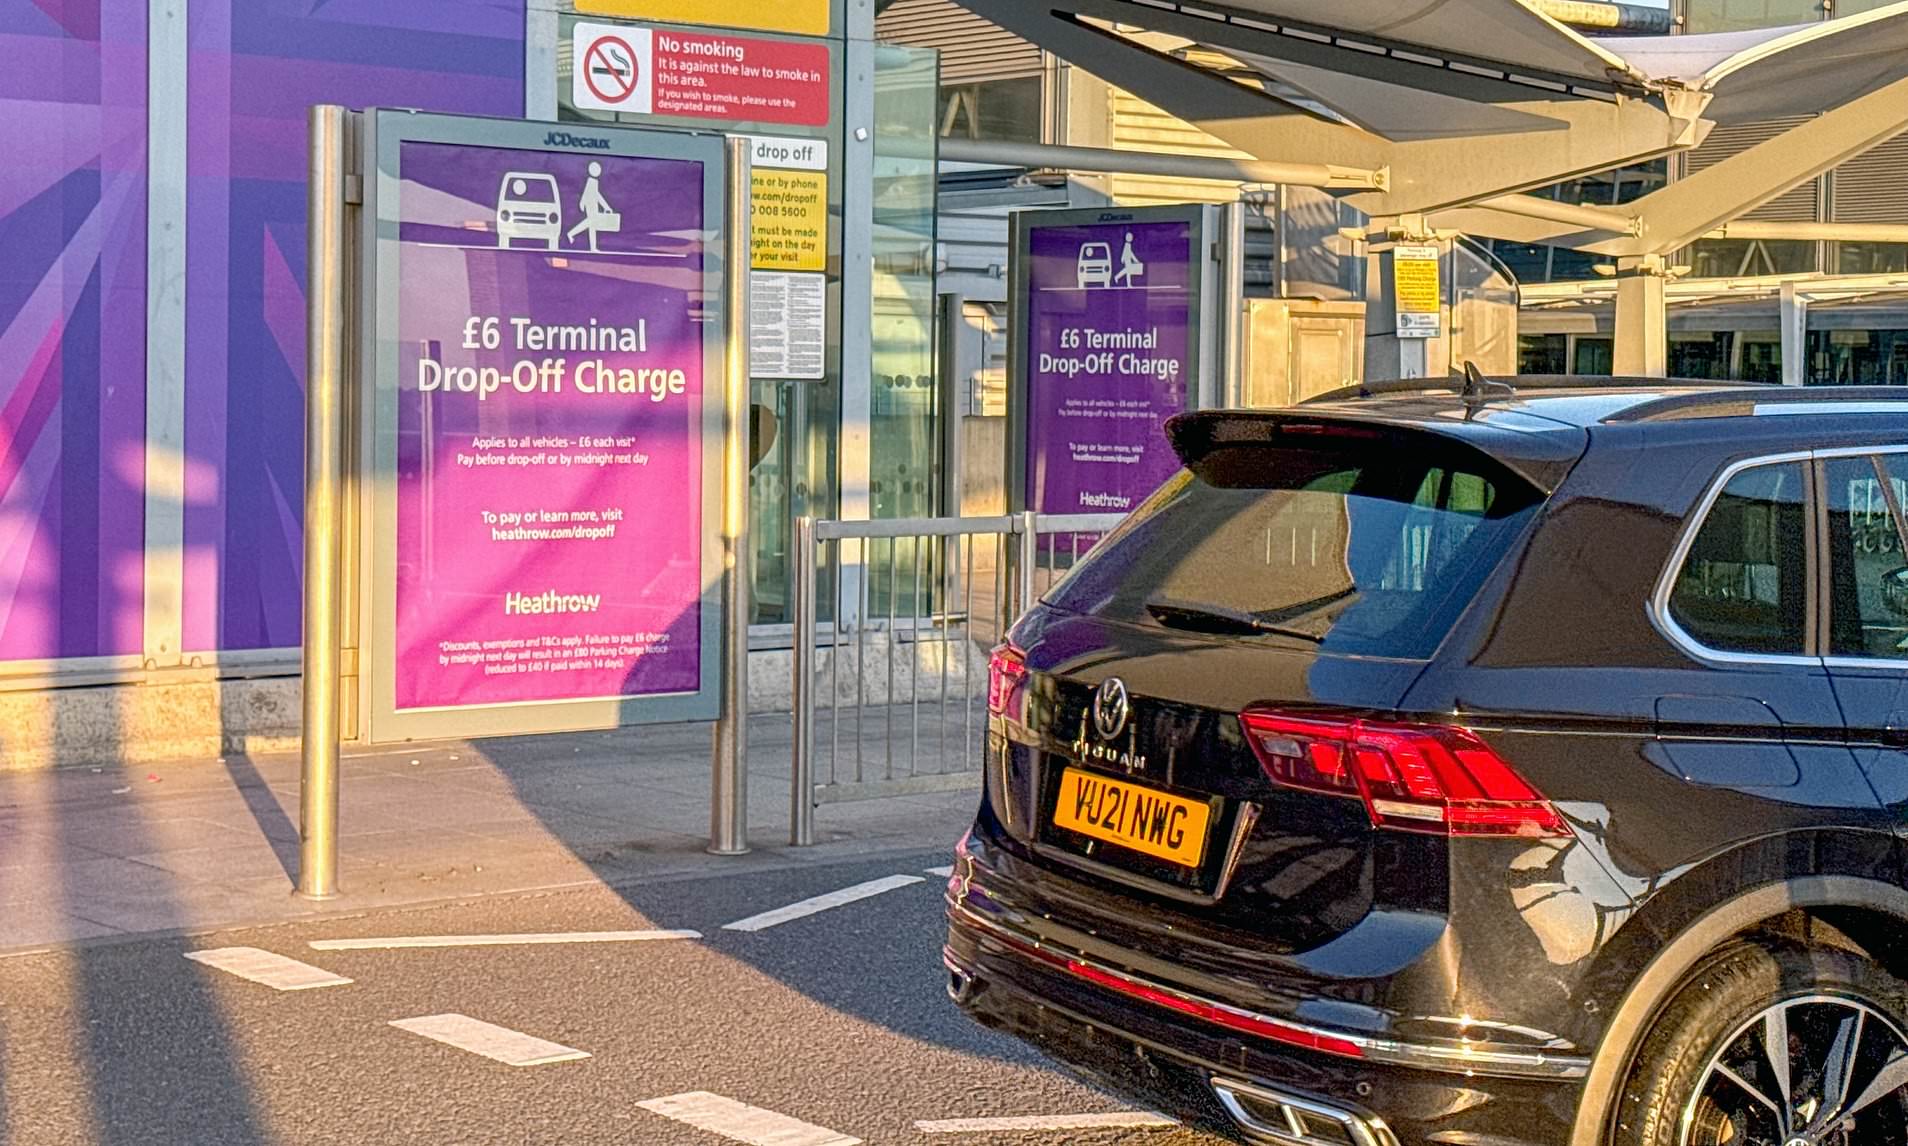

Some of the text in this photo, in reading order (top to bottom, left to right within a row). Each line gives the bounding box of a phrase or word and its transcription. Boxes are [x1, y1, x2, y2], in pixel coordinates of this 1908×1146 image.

[658, 36, 744, 62] No smoking
[658, 58, 821, 82] It is against the law to smoke in
[658, 72, 708, 87] this area.
[658, 88, 796, 108] If you wish to smoke, please use the
[658, 101, 703, 112] designated
[544, 132, 610, 149] JCDecaux
[757, 143, 813, 162] drop off
[778, 178, 788, 189] by
[791, 179, 818, 190] phone
[758, 226, 780, 236] must
[782, 227, 792, 236] be
[794, 229, 818, 238] made
[772, 240, 783, 249] on
[785, 240, 799, 250] the
[801, 241, 816, 252] day
[760, 252, 779, 262] your
[781, 252, 798, 262] visit
[462, 316, 647, 352] £6 Terminal
[1060, 328, 1157, 349] £6 Terminal
[1040, 353, 1180, 380] Drop-Off Charge
[418, 358, 686, 402] Drop-Off Charge
[472, 436, 506, 450] Applies
[508, 438, 518, 448] to
[520, 436, 530, 448] all
[532, 436, 568, 448] vehicles
[579, 436, 591, 448] £6
[593, 436, 614, 448] each
[457, 452, 649, 468] Pay before drop-off or by midnight next day
[1080, 492, 1130, 508] Heathrow
[482, 508, 624, 526] To pay or learn more, visit
[492, 524, 616, 541] heathrow.com/dropoff
[505, 589, 601, 616] Heathrow
[1075, 777, 1188, 850] VU21 NWG
